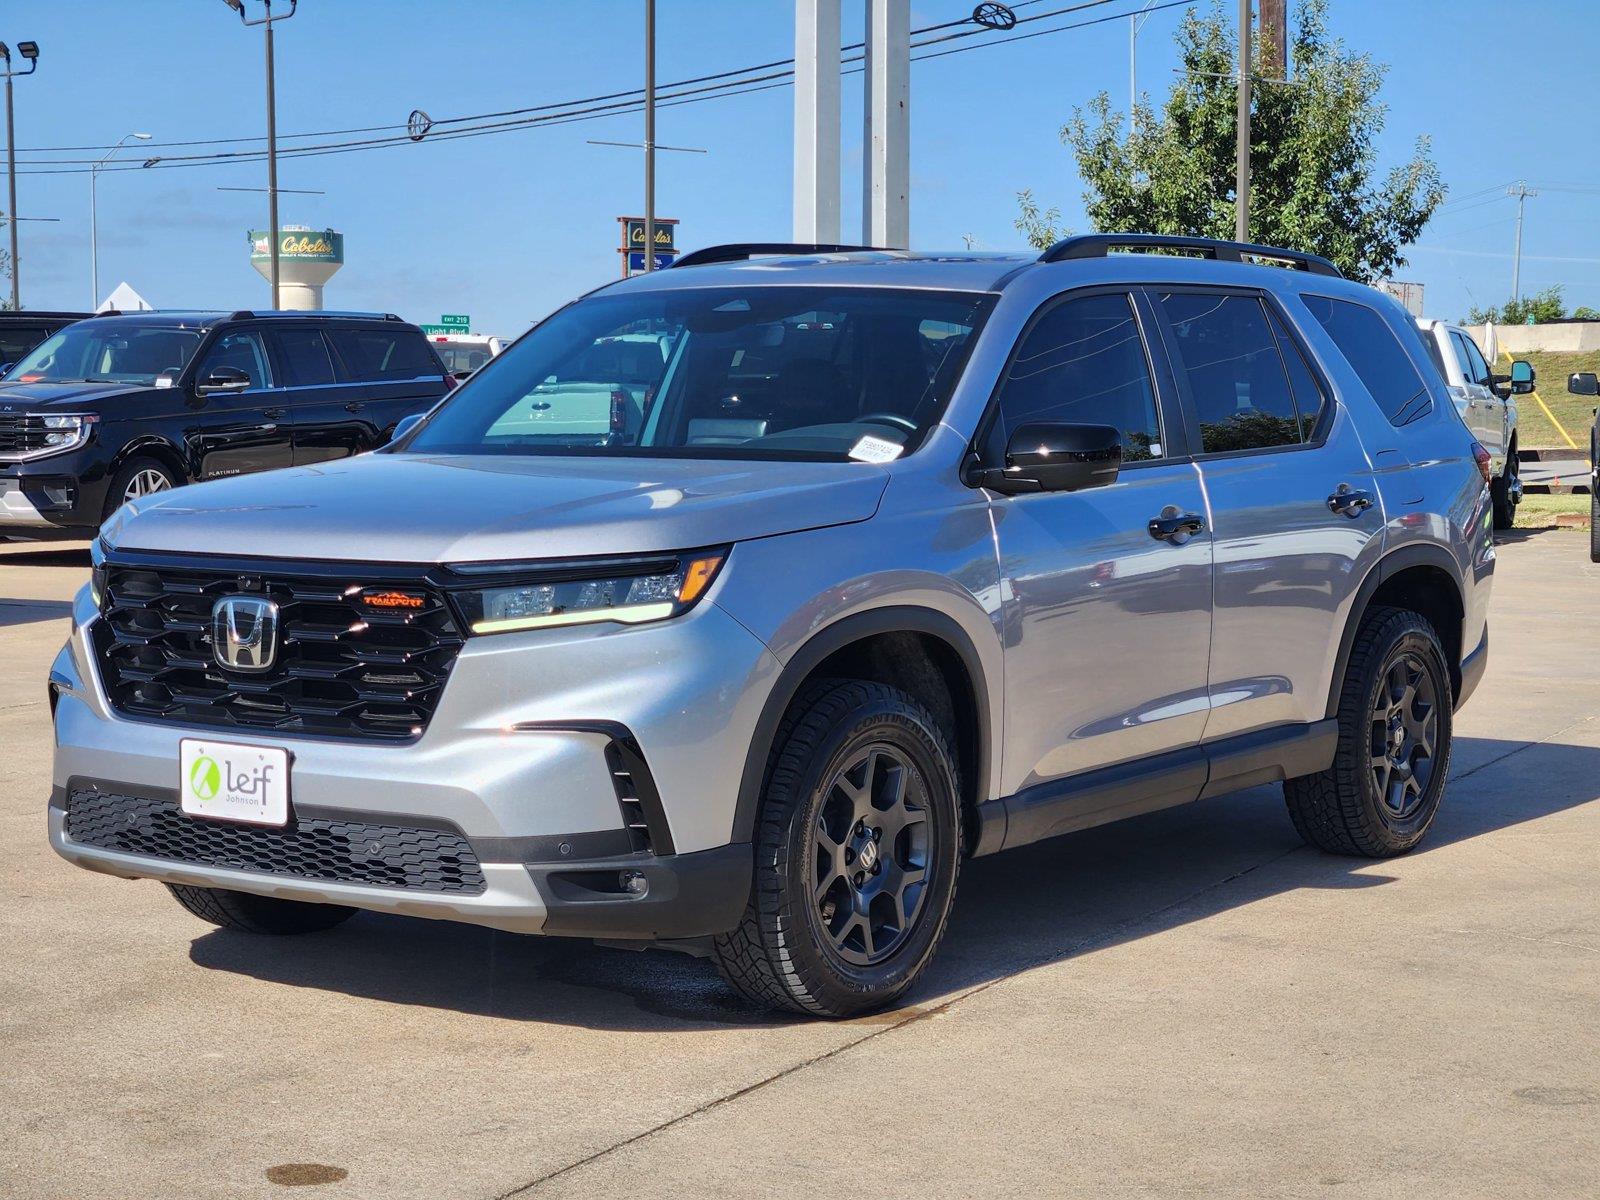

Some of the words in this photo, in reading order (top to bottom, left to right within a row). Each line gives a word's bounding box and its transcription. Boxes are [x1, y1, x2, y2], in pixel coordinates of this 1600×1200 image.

[632, 227, 671, 244] Cala's
[456, 316, 467, 324] 219
[363, 596, 424, 607] TRAILSPORT
[225, 794, 259, 806] Johnson
